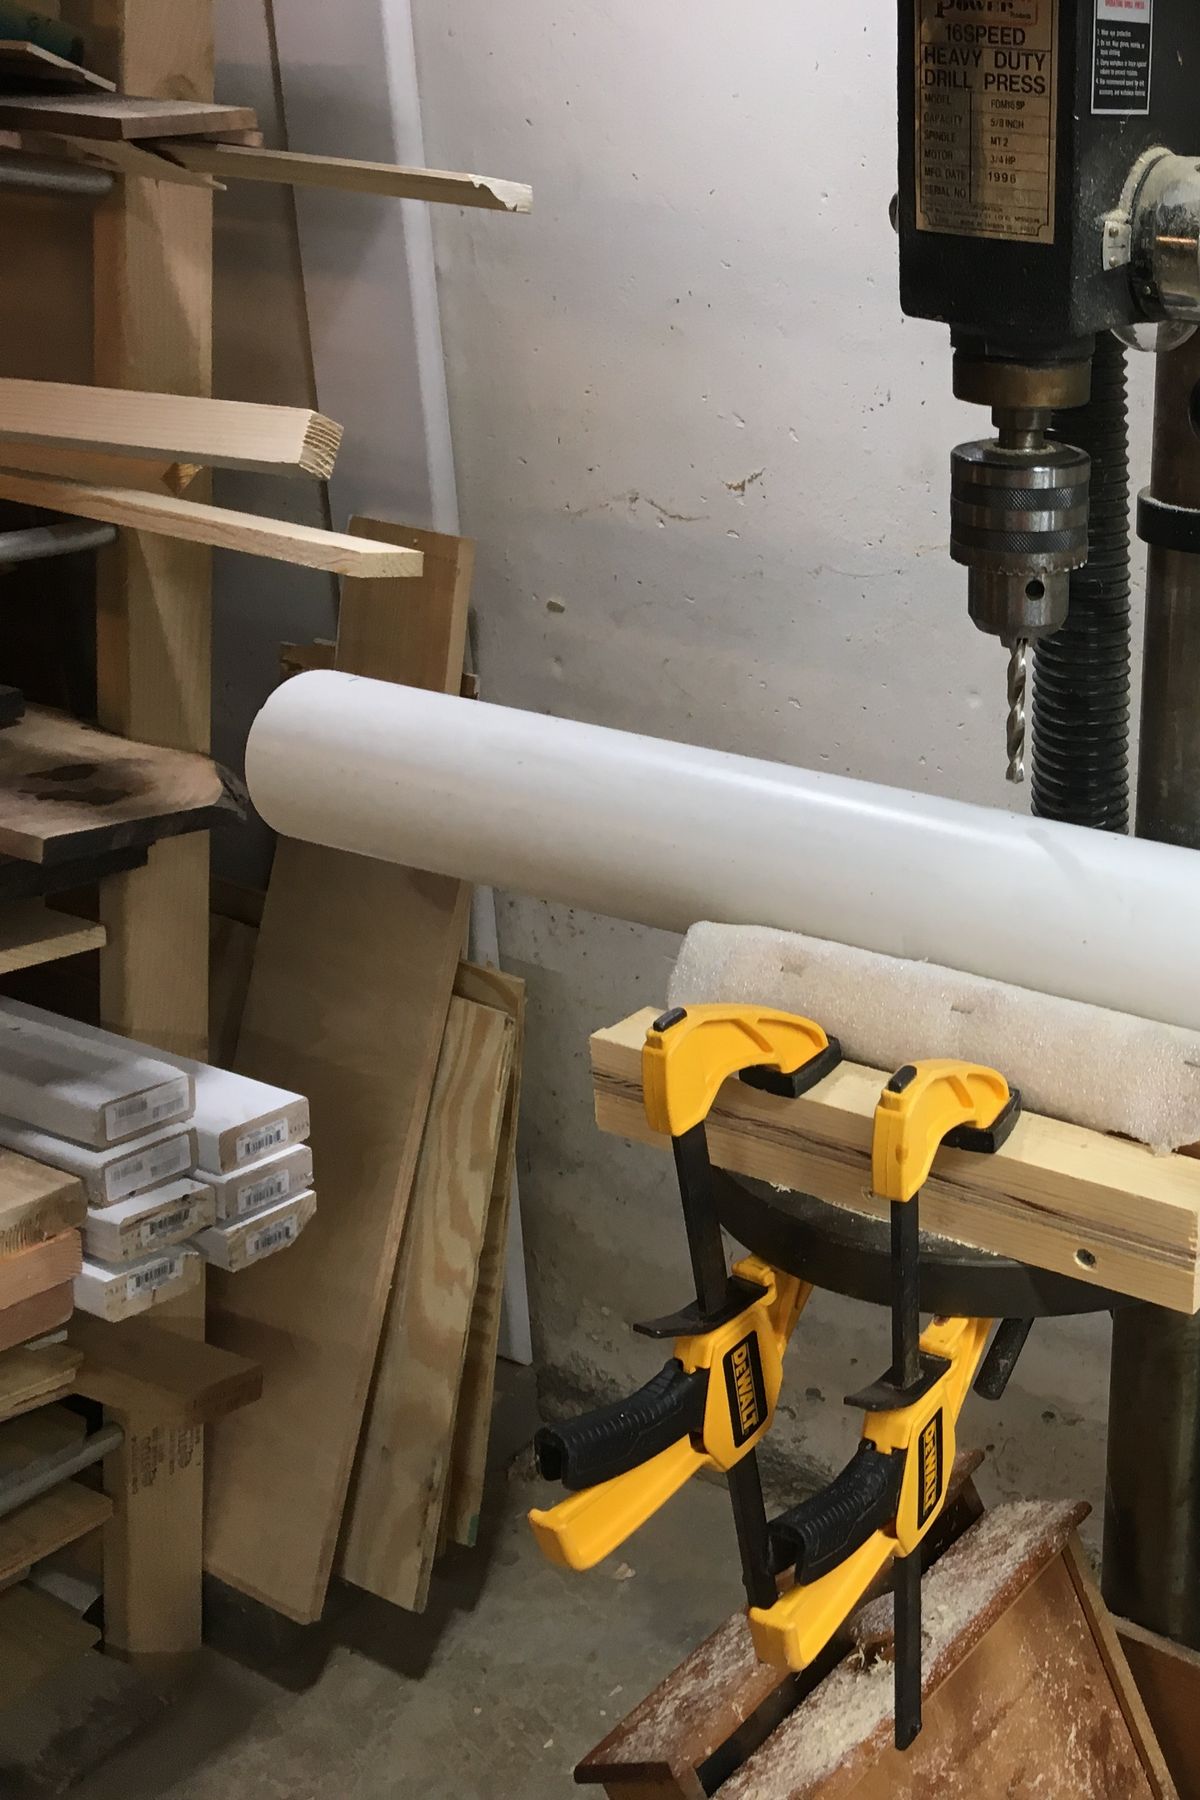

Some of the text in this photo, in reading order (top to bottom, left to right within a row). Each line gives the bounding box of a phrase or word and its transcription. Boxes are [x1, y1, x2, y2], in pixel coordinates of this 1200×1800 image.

[924, 46, 1046, 71] HEAVY DUTY
[924, 69, 1046, 94] DRILL PRESS
[924, 149, 953, 161] MOTOR
[945, 168, 965, 180] DATE
[988, 171, 1017, 184] 1996
[733, 1343, 758, 1431] DEWALT
[925, 1421, 937, 1511] DEWALT
